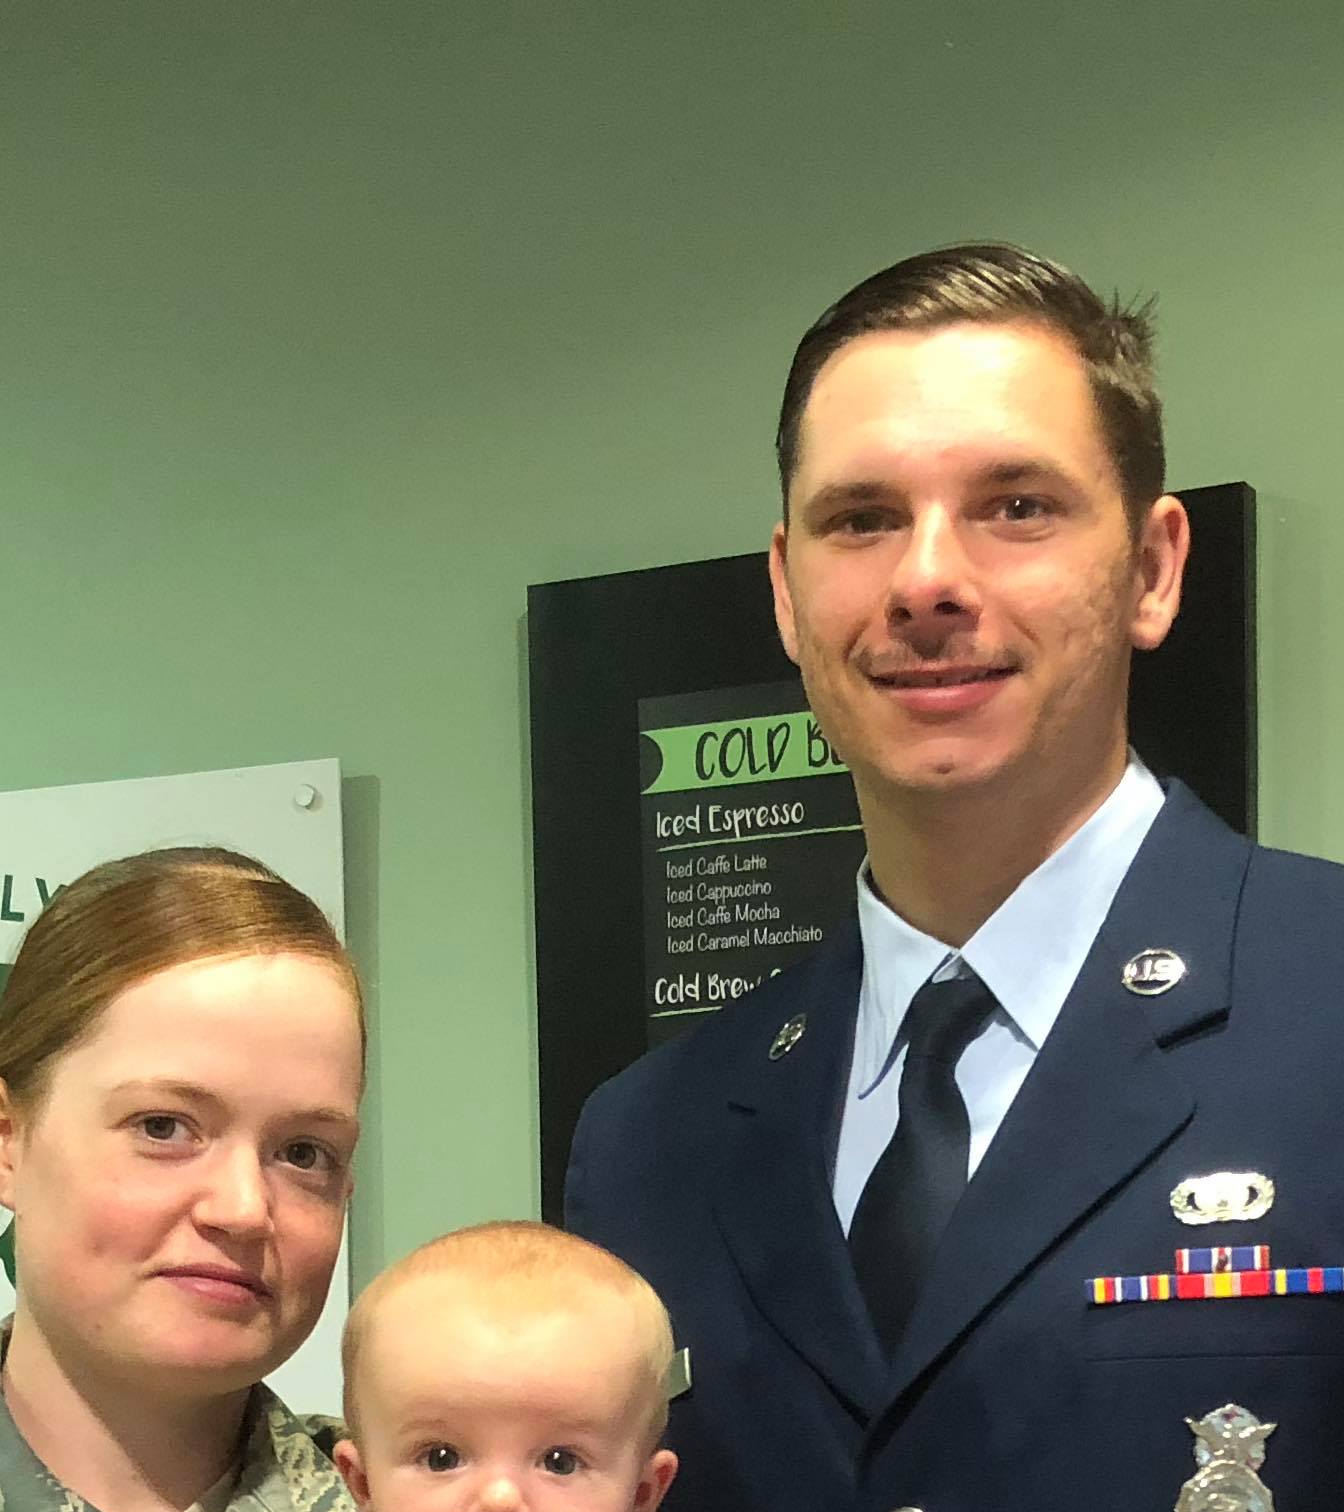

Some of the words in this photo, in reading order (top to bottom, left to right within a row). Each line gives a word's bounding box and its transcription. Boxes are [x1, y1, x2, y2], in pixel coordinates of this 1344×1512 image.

[695, 721, 791, 781] COLD
[656, 804, 701, 838] Iced
[708, 802, 804, 839] Espresso
[666, 858, 693, 879] Iced
[697, 855, 730, 876] Caffe
[734, 854, 767, 871] Latte
[666, 884, 693, 904] Iced
[697, 879, 772, 904] Cappuccino
[667, 909, 693, 928] Iced
[697, 905, 731, 926] Caffe
[735, 902, 780, 921] Mocha
[667, 933, 694, 954] Iced
[697, 929, 750, 951] Caramel
[754, 925, 823, 945] Macchiato
[655, 972, 700, 1004] Cold
